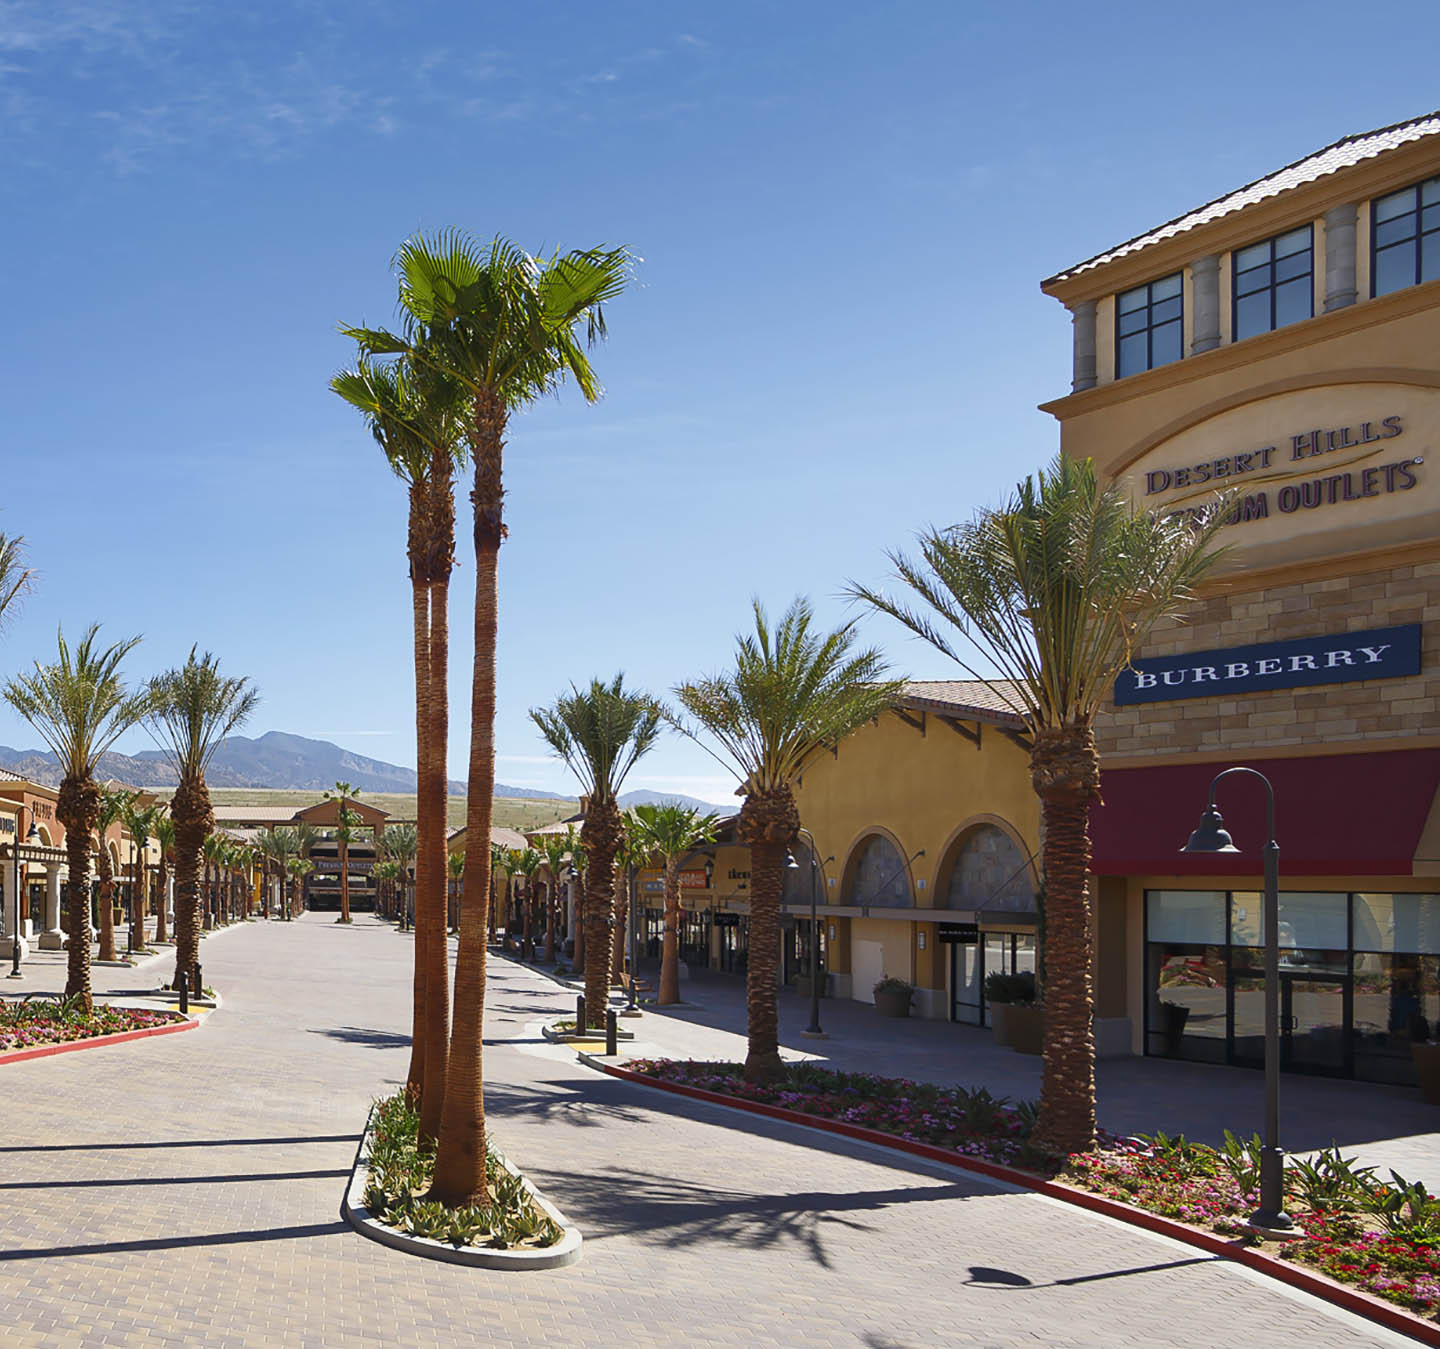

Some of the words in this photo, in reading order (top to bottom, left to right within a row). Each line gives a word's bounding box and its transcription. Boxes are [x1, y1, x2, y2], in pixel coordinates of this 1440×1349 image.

[1144, 446, 1277, 496] DESERT
[1289, 415, 1403, 462] HILLS
[1133, 644, 1392, 690] BURBERRY
